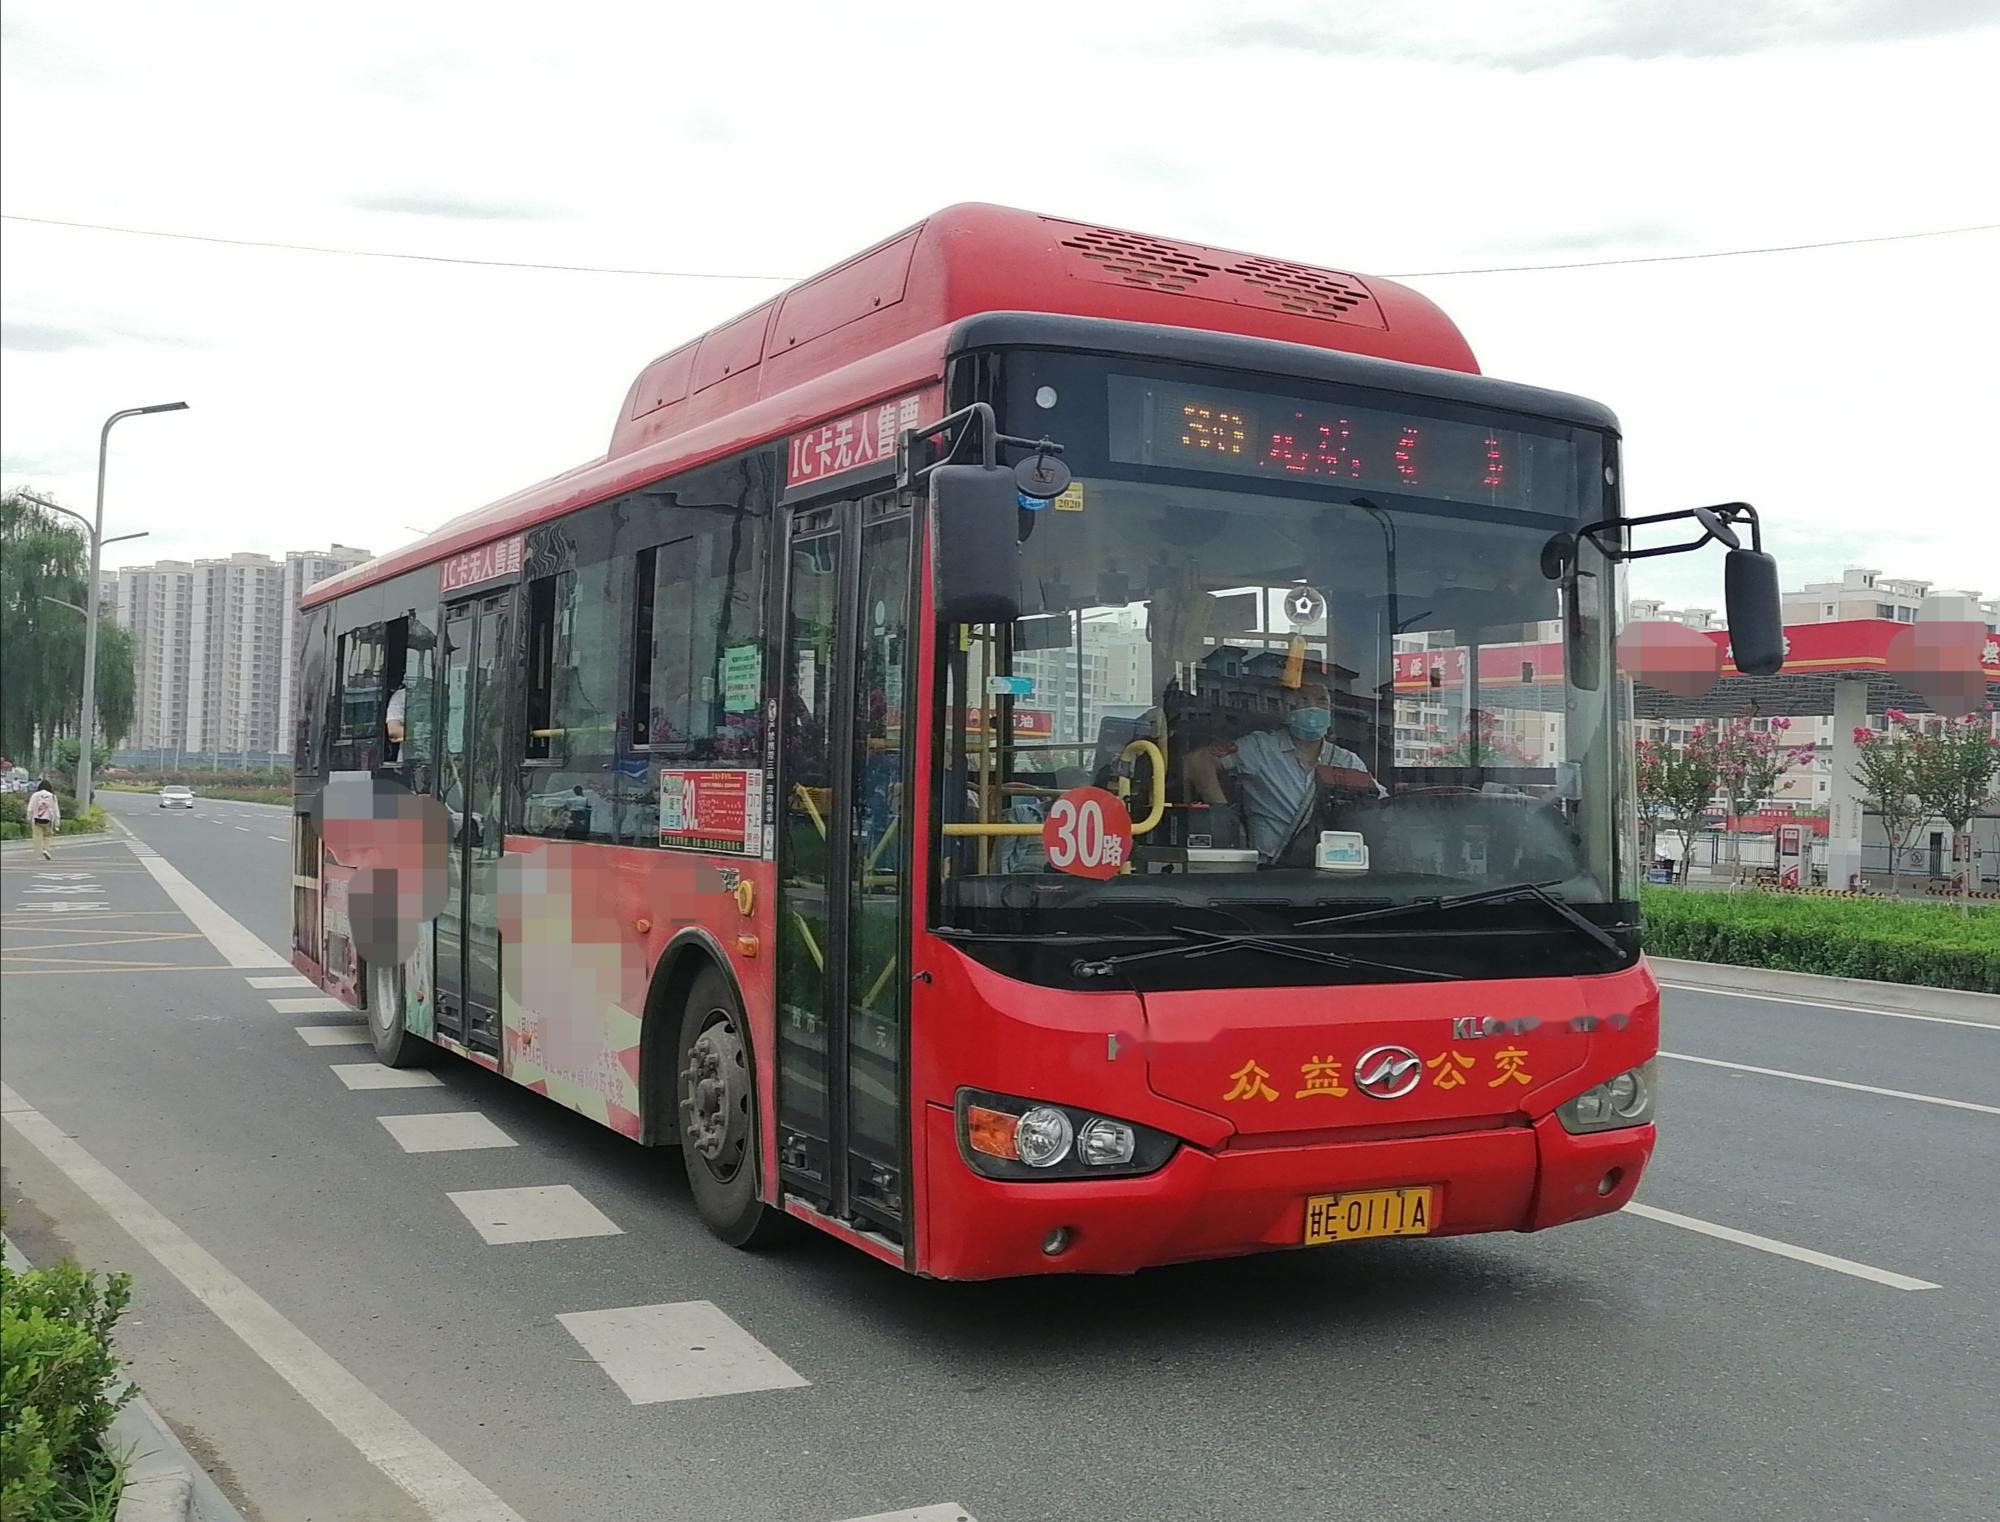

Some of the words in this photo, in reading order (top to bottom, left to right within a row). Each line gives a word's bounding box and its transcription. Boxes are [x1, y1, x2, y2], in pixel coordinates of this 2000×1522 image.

[791, 395, 920, 478] IC卡无人售票
[1055, 499, 1081, 508] 2020
[443, 536, 521, 588] IC卡无人售票
[1049, 799, 1123, 868] 30路
[1223, 1046, 1533, 1102] 众益公交
